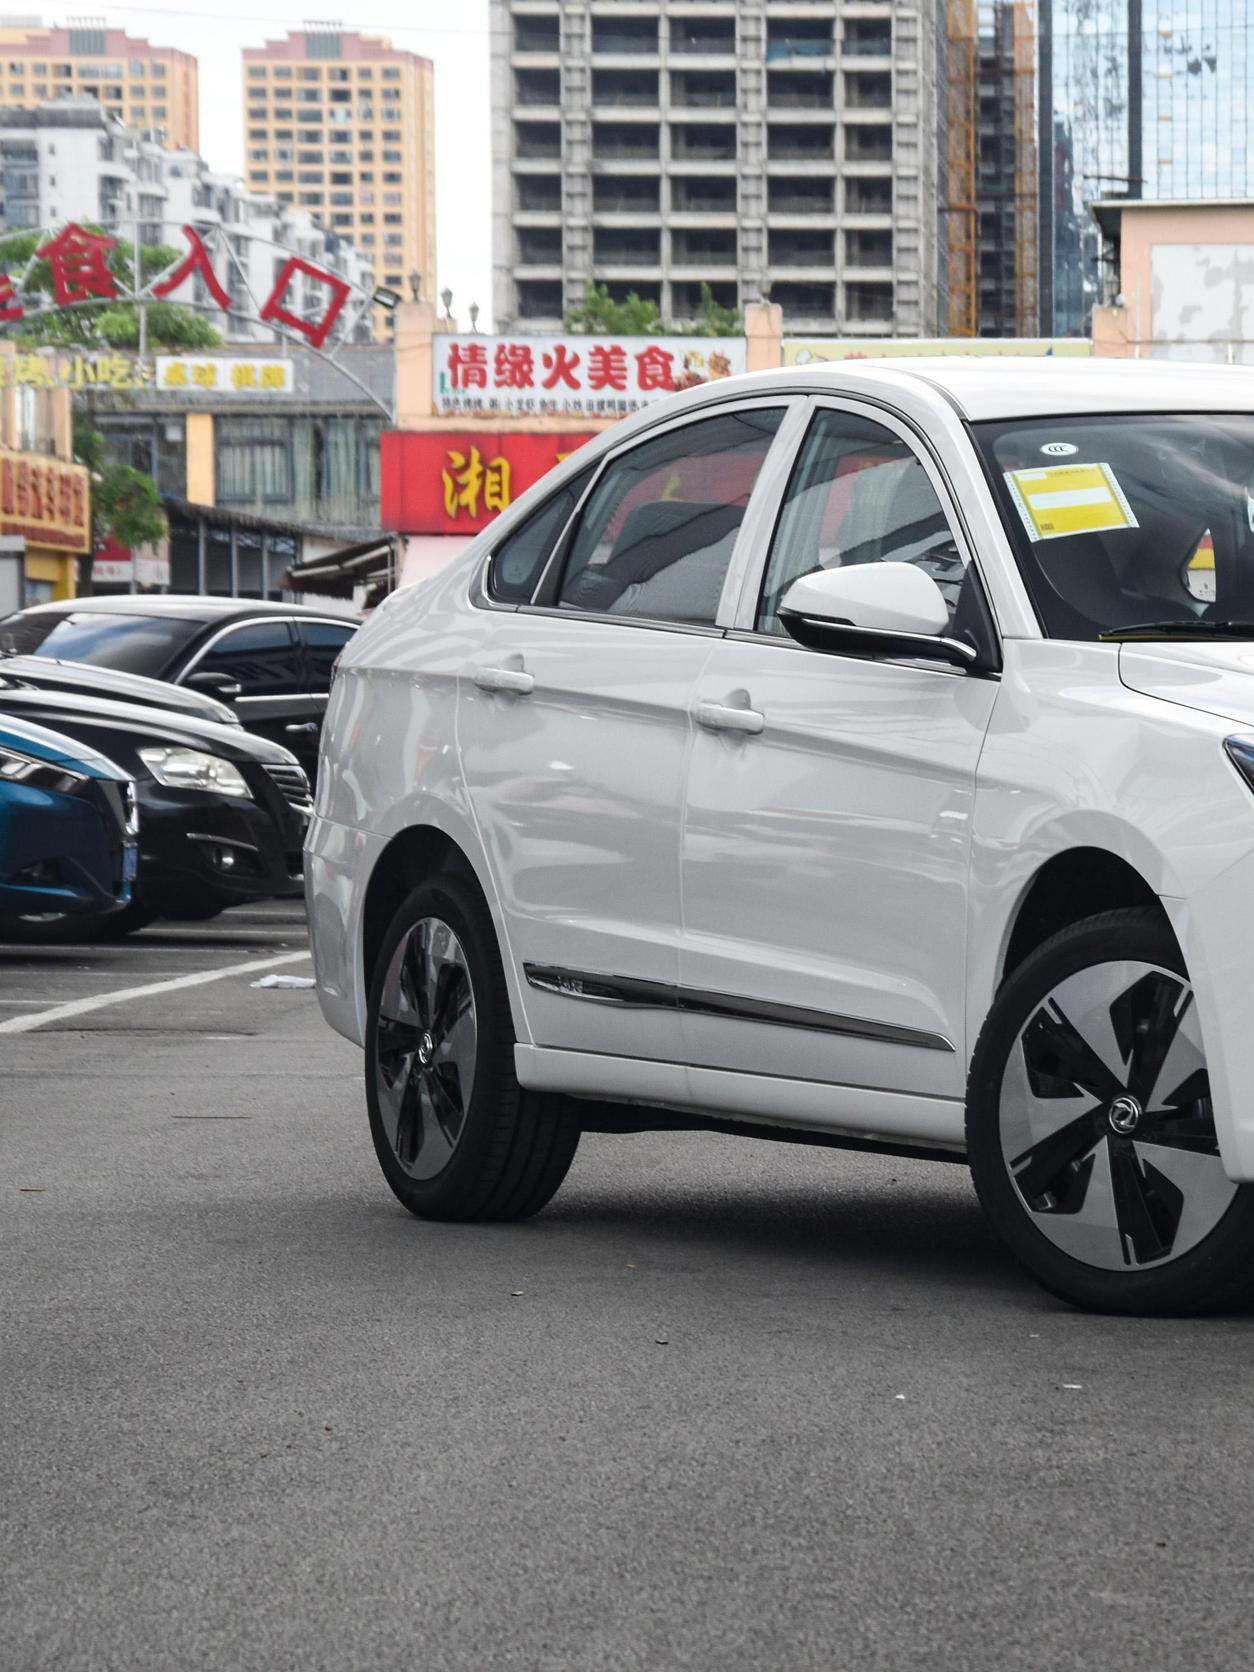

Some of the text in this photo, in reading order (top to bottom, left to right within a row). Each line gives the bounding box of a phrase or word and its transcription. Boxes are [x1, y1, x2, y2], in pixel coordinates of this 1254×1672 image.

[447, 342, 675, 391] 情缘火美食
[442, 445, 511, 519] 湘
